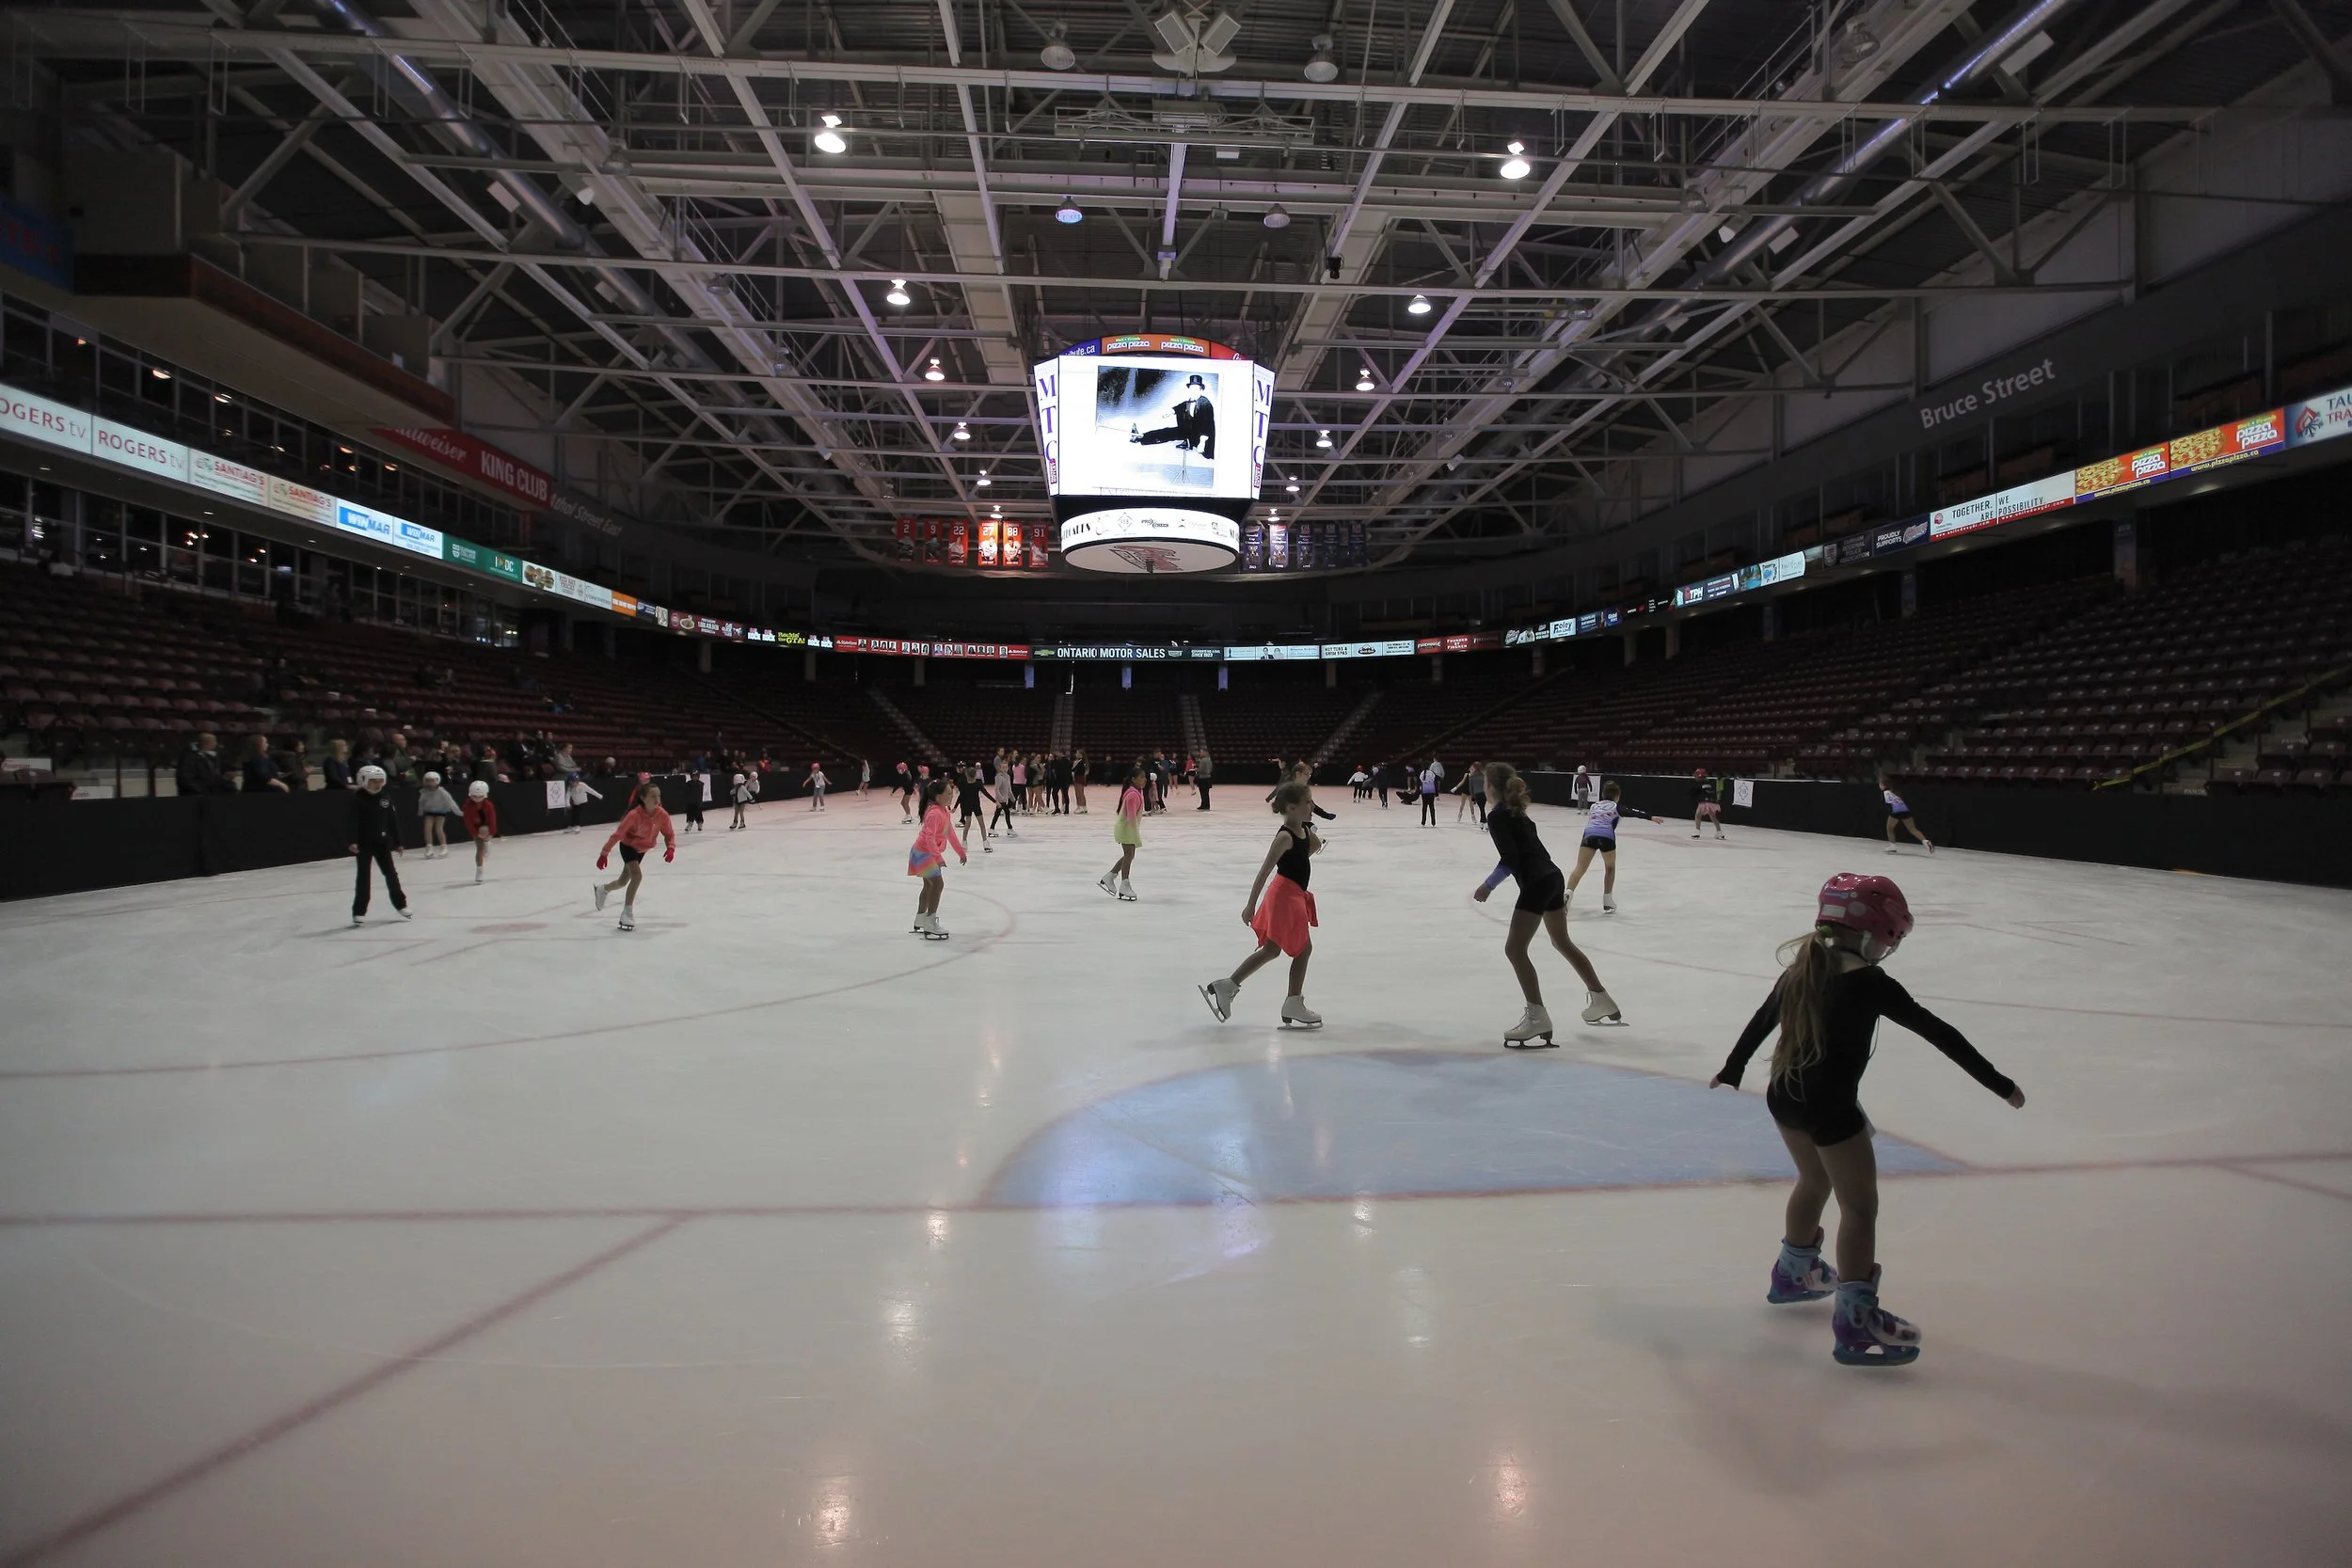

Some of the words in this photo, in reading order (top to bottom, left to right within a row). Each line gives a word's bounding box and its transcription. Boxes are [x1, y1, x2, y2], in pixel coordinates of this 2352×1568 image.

[1107, 341, 1127, 351] pizza
[1161, 341, 1183, 350] pizza
[1184, 343, 1204, 353] pizza
[1920, 394, 1979, 429] Bruce
[1981, 358, 2056, 404] Street
[70, 420, 86, 439] tv
[2235, 422, 2271, 442] pizza
[98, 430, 167, 464] ROGERS
[385, 428, 467, 462] dweiser
[2241, 430, 2277, 450] pizza
[2132, 454, 2161, 472] pizza
[2137, 461, 2166, 478] pizza
[481, 451, 514, 488] KING
[516, 468, 548, 501] CLUB
[1998, 496, 2009, 505] WE
[347, 512, 390, 534] WINMAR
[1980, 511, 1993, 521] ARE
[405, 526, 435, 543] WINMAR
[953, 526, 964, 535] 22
[982, 527, 994, 536] 27
[1008, 528, 1018, 536] 88
[1034, 529, 1045, 537] 91
[1878, 531, 1900, 542] PROUDLY
[1877, 536, 1901, 548] SUPPORTS
[1057, 648, 1097, 658] ONTARIO
[1100, 648, 1134, 658] MOTOR
[1136, 648, 1166, 658] SALES
